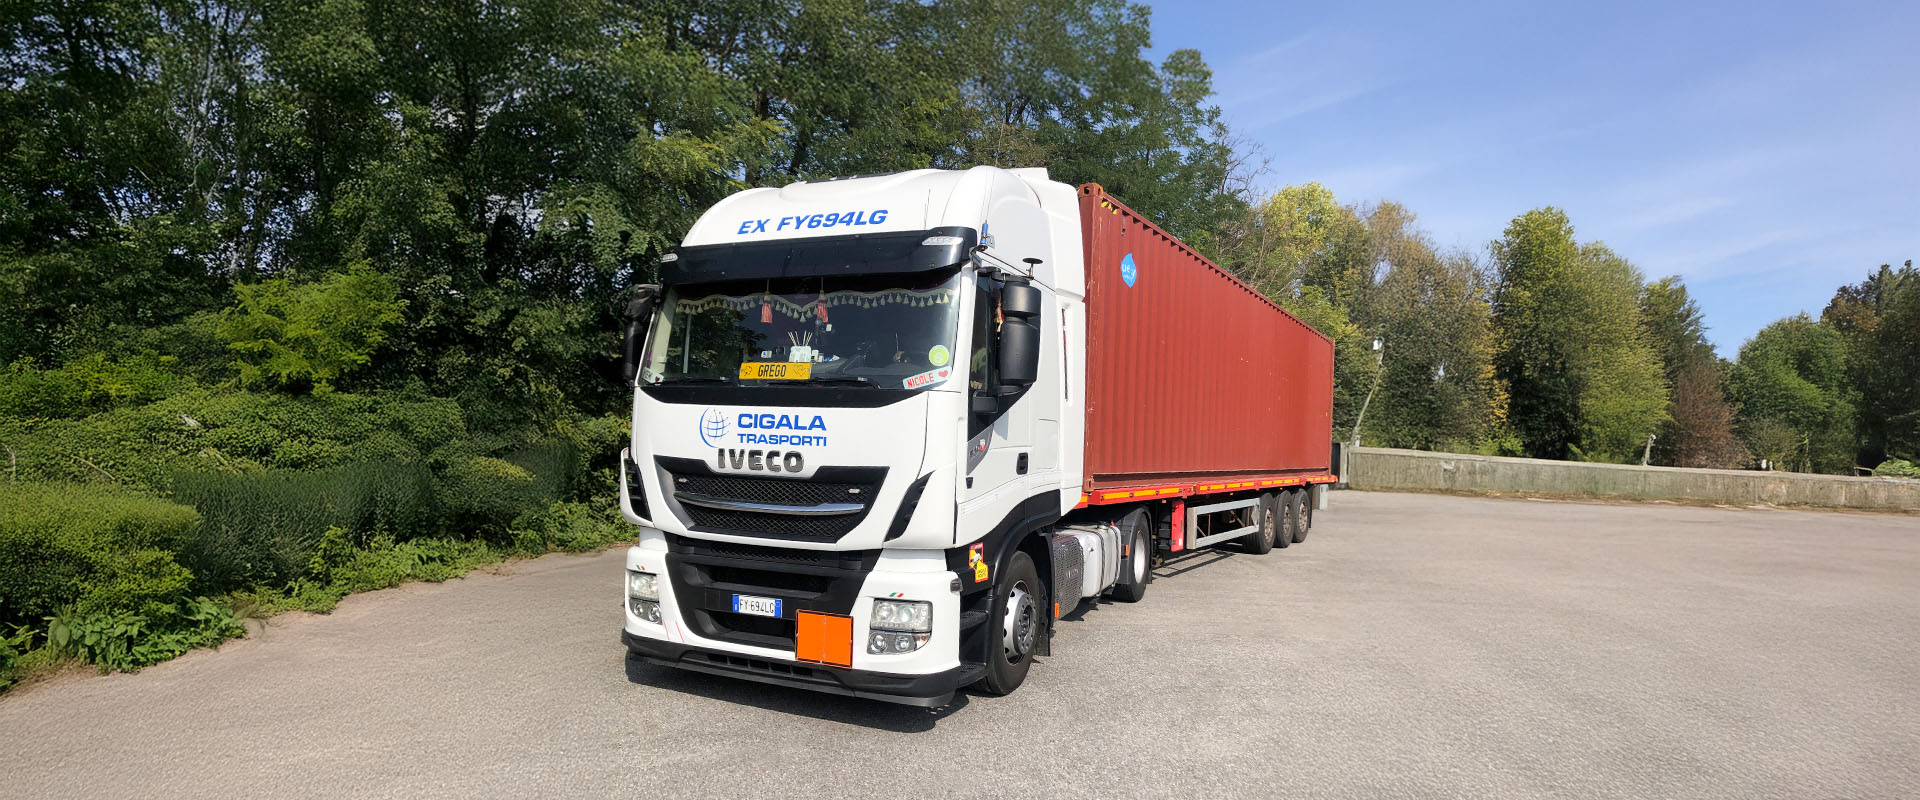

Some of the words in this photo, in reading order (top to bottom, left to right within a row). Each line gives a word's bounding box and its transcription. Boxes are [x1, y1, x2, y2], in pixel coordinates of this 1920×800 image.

[737, 218, 770, 235] EX
[776, 209, 889, 231] FY694LG
[757, 364, 787, 378] GREGO
[906, 372, 935, 389] NICOLE
[737, 413, 827, 431] CIGALA
[737, 433, 828, 447] TRASPORTI
[717, 447, 805, 473] IVECO
[739, 598, 775, 614] FY694LG
